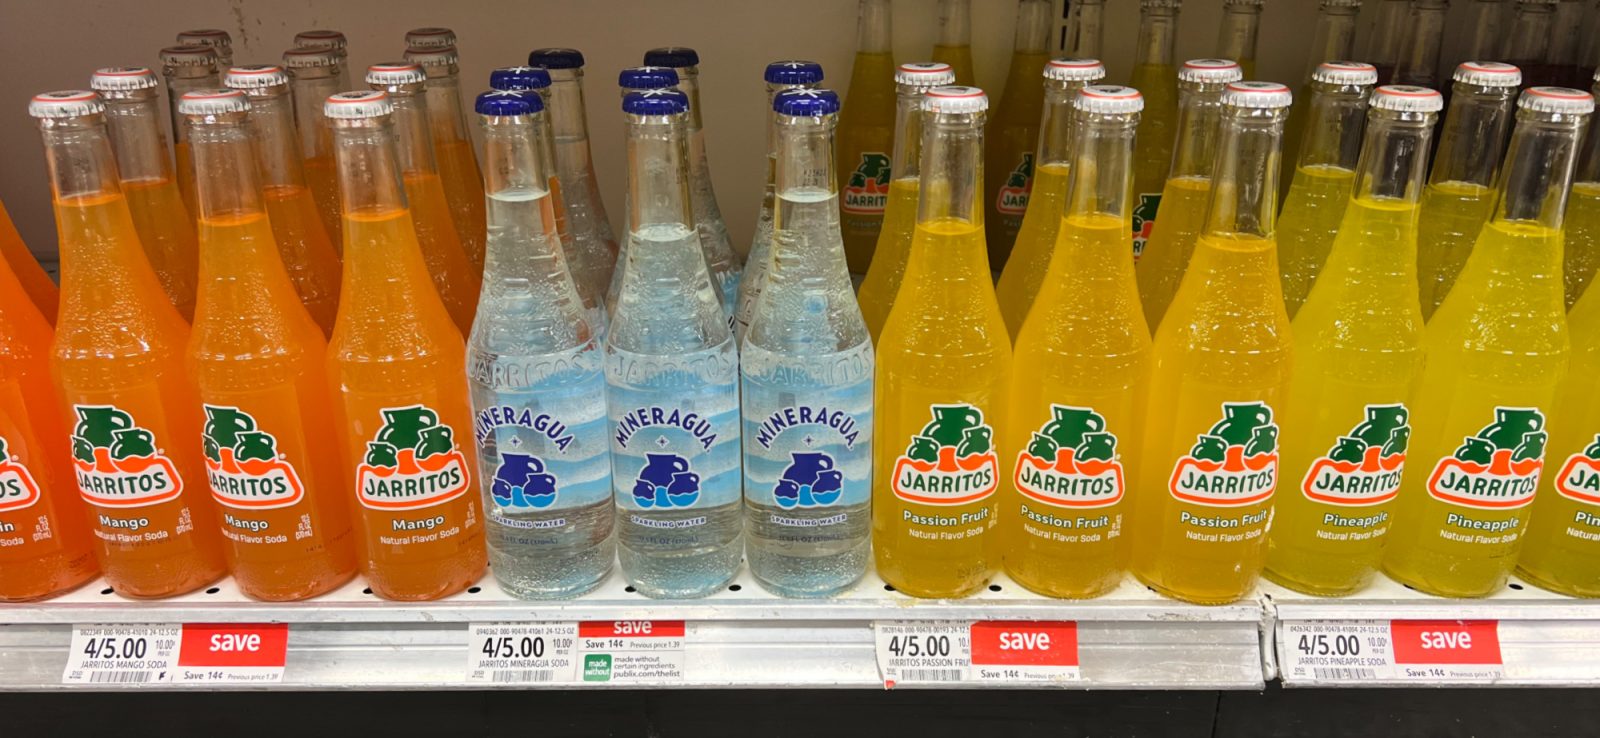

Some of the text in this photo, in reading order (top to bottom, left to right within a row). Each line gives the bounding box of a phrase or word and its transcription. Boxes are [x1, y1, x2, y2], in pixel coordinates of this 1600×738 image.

[476, 407, 573, 447] MINERAGUA
[616, 407, 717, 449] MINERAGUA
[757, 407, 859, 449] MINERAGUA
[78, 471, 167, 494] JARRITOS
[365, 467, 460, 497] JARRITOS
[901, 468, 991, 493] JARRITOS
[1021, 467, 1114, 496] JARRITOS
[1181, 468, 1273, 494] JARRITOS
[1441, 472, 1537, 497] JARRITOS
[1570, 470, 1600, 491] JA
[99, 515, 149, 530] Mango
[224, 514, 269, 531] Mango
[392, 515, 444, 531] Mango
[535, 518, 566, 528] WATER
[676, 516, 706, 528] WATER
[771, 513, 847, 527] SPARKLING WATER
[903, 510, 957, 526] Passion
[961, 507, 989, 524] Fruit
[1021, 505, 1072, 528] Passion
[1076, 516, 1108, 529] Fruit
[1181, 509, 1267, 527] Passion Fruit
[1323, 511, 1388, 528] Pineapple
[1447, 513, 1519, 533] Pineapple
[118, 532, 142, 542] Flavor
[145, 530, 168, 541] Soda
[240, 534, 263, 544] Flavor
[265, 535, 287, 544] Soda
[412, 534, 438, 544] Flavor
[440, 527, 459, 539] Soda
[940, 531, 965, 540] Flavor
[1053, 532, 1078, 542] Flavor
[1080, 533, 1101, 543] Soda
[1220, 533, 1244, 542] Flavor
[1350, 531, 1371, 541] Flavor
[1475, 535, 1500, 544] Flavor
[614, 620, 652, 634] save
[84, 638, 147, 659] 4/5.00
[209, 633, 261, 651] save
[482, 637, 544, 658] 4/5.00
[586, 640, 604, 648] Save
[609, 640, 623, 648] 14¢
[654, 641, 667, 649] price
[889, 635, 950, 657] 4/5.00
[999, 632, 1050, 650] save
[1298, 634, 1360, 655] 4/5.00
[1420, 631, 1472, 649] save
[81, 661, 167, 669] JARRITOS MANGO SODA
[479, 660, 508, 668] JARRITOS
[510, 660, 549, 668] MINERAGUA
[889, 659, 920, 667] JARRITOS
[1299, 657, 1387, 665] JARRITOS PINEAPPLE SODA
[184, 671, 204, 679] Save
[208, 671, 223, 680] 14¢
[251, 673, 265, 681] price
[981, 670, 1000, 678] Save
[1004, 670, 1019, 678] 14¢
[1406, 668, 1426, 677] Save
[1429, 669, 1445, 677] 14¢
